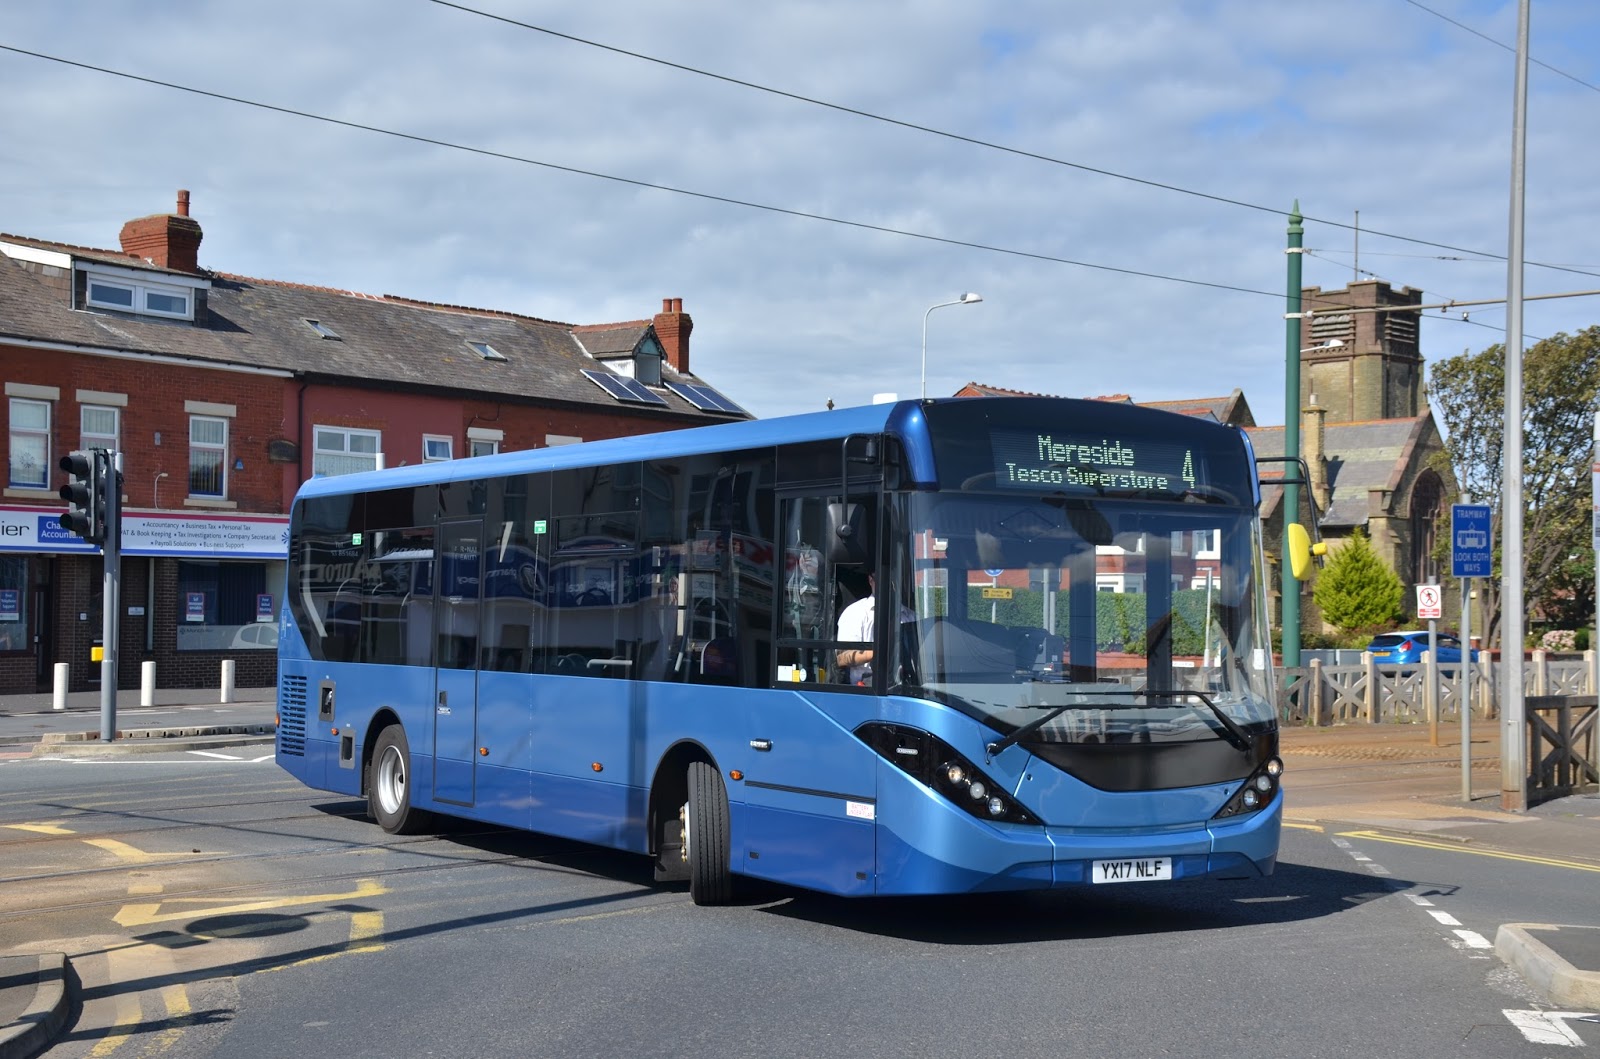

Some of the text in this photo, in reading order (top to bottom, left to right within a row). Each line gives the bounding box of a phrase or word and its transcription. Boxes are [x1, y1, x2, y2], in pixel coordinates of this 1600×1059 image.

[1037, 434, 1135, 466] Mereside
[1181, 449, 1195, 489] 4
[1005, 462, 1168, 490] Tesco Superstore
[1456, 509, 1487, 519] TRAMWAY
[146, 521, 180, 530] Accountancy
[185, 522, 207, 530] Business
[151, 530, 172, 539] Keeping
[187, 532, 222, 540] Investigations
[227, 533, 250, 541] Company
[154, 540, 173, 548] Payroll
[225, 542, 245, 550] Support
[1455, 552, 1489, 562] LOOK BOTH
[1463, 563, 1481, 572] WAYS
[1101, 860, 1163, 879] YX17 NLF
